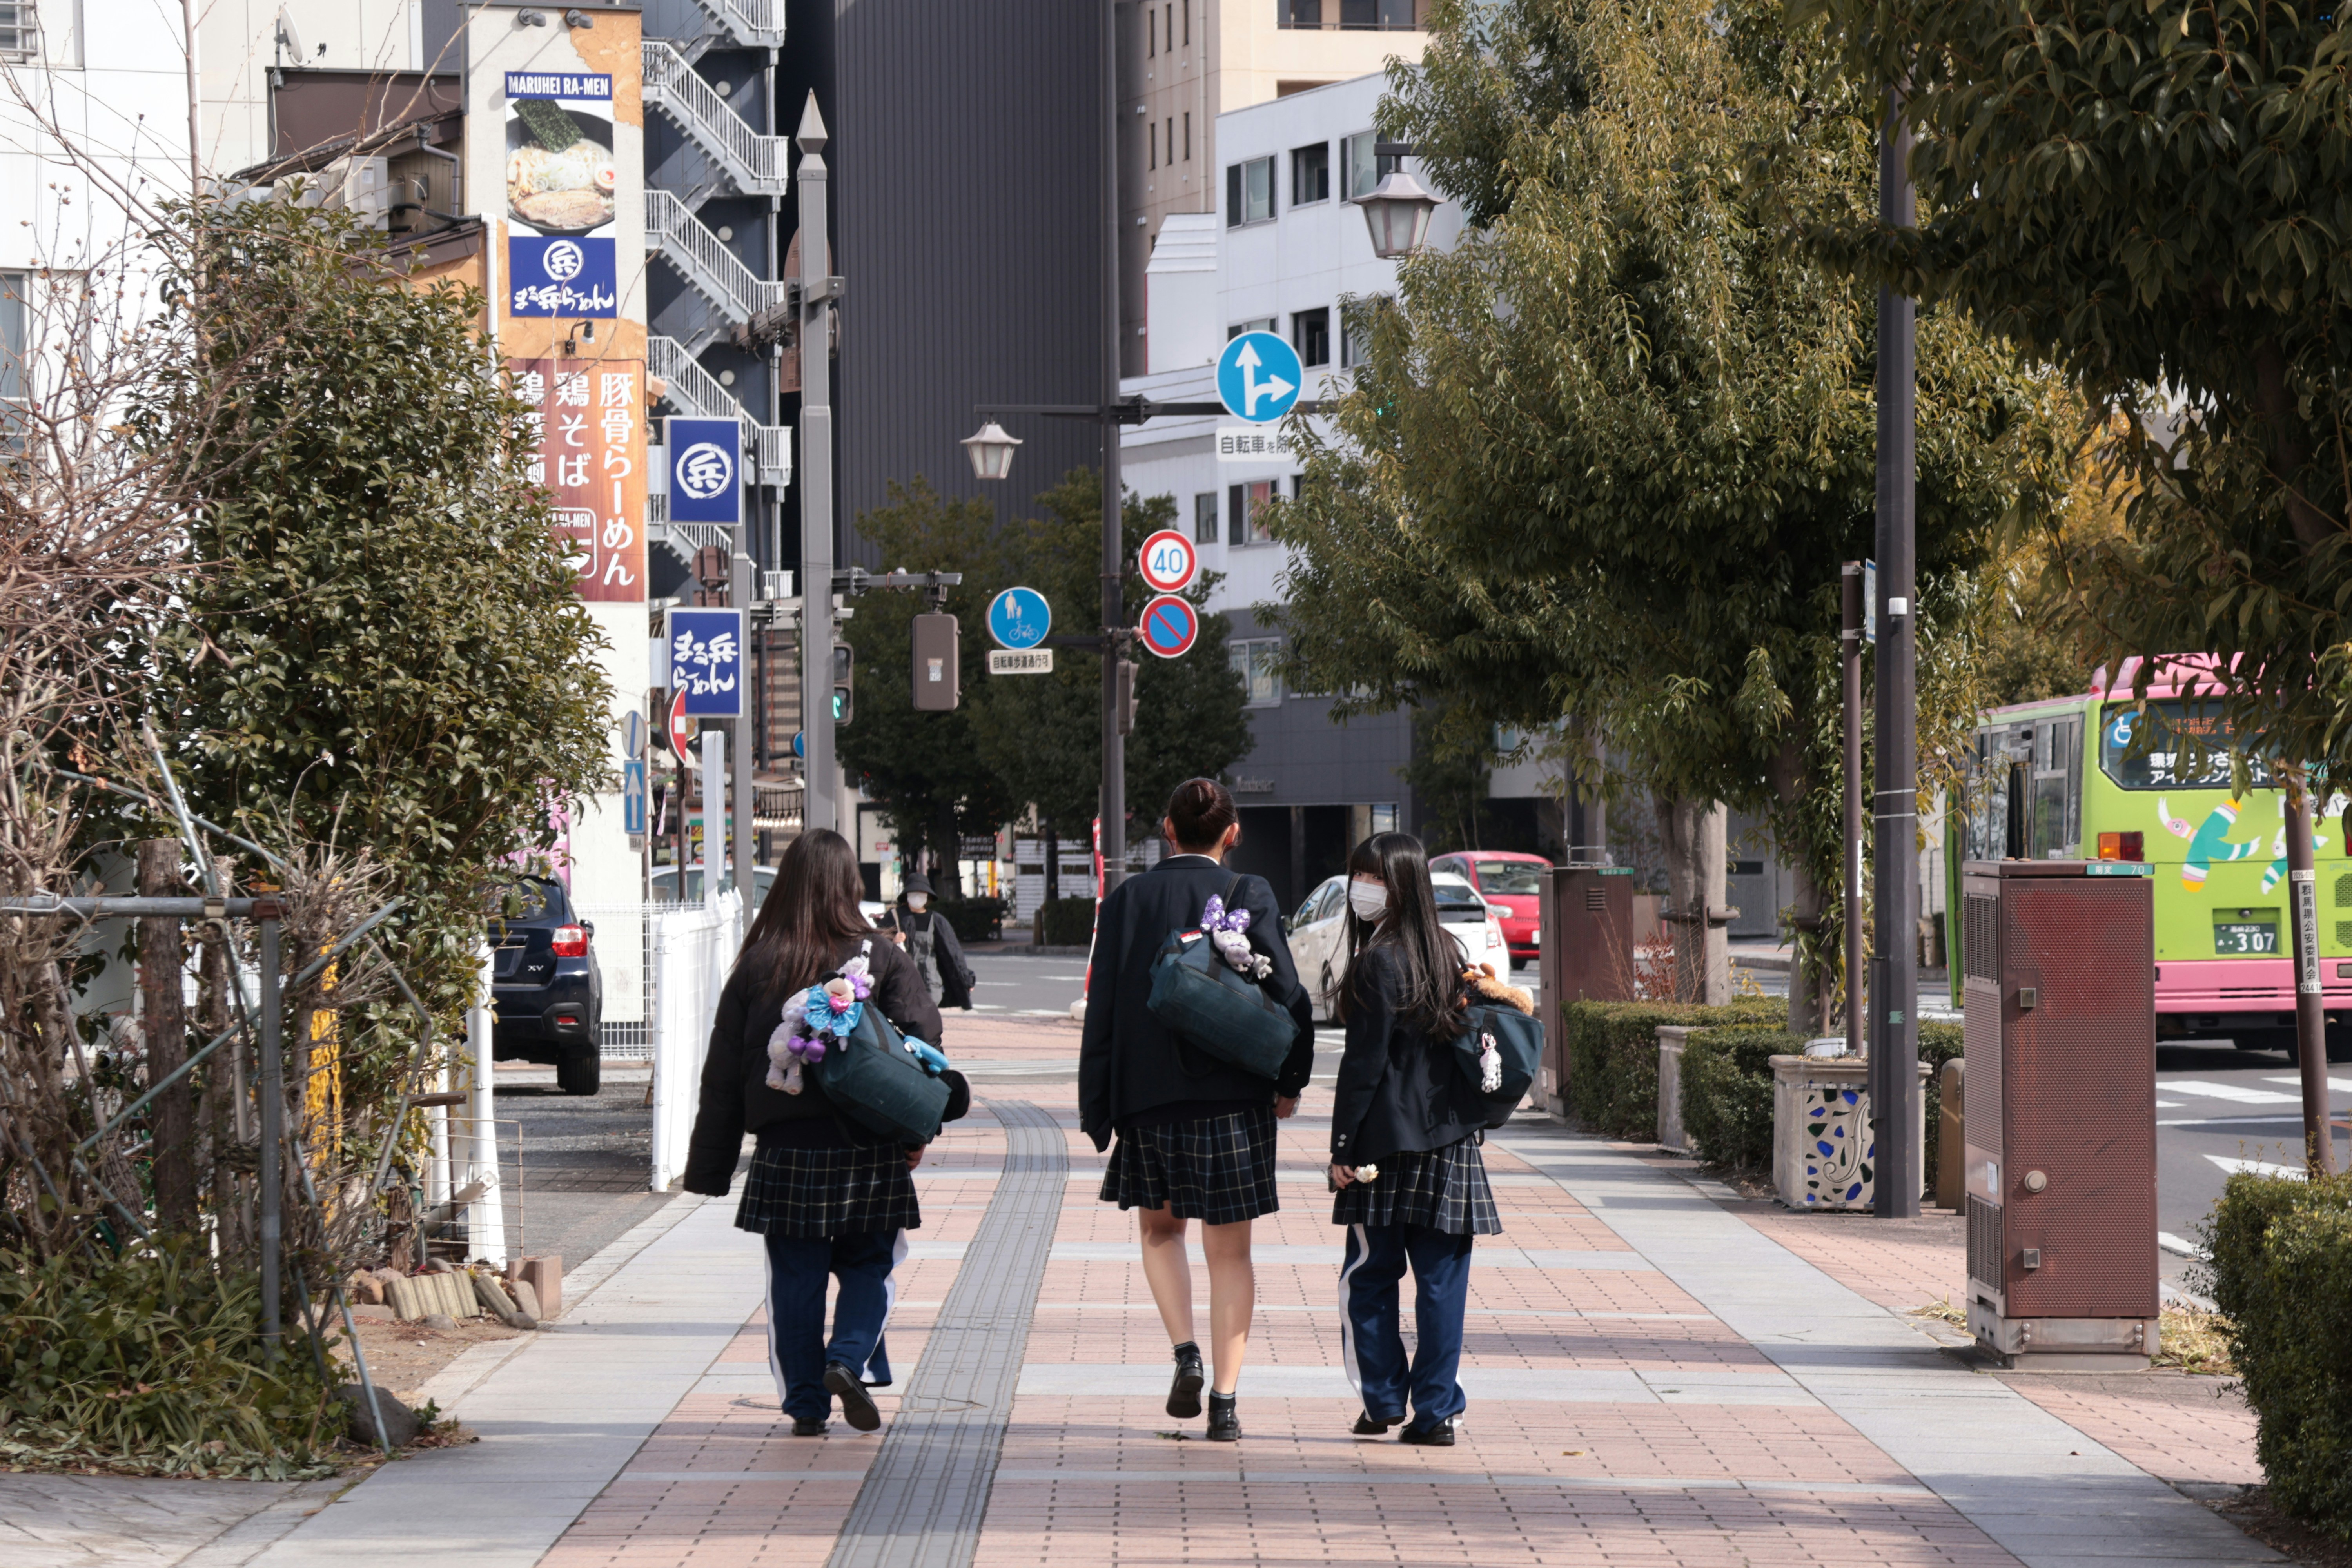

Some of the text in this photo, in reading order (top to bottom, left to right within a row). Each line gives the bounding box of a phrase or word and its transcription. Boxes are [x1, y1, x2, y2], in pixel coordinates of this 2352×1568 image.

[508, 75, 609, 96] MARUHEI RA-MEN
[514, 283, 615, 311] まる兵らーめん
[555, 370, 592, 487] 鶏そば
[599, 372, 635, 586] 豚骨らーめん
[1154, 548, 1183, 573] 40
[673, 630, 739, 666] まる兵
[993, 655, 1048, 669] 自転車歩道通行可
[673, 663, 735, 695] らーめん
[2095, 865, 2145, 875] 南変 70
[2302, 884, 2317, 980] 群馬県公安委員会
